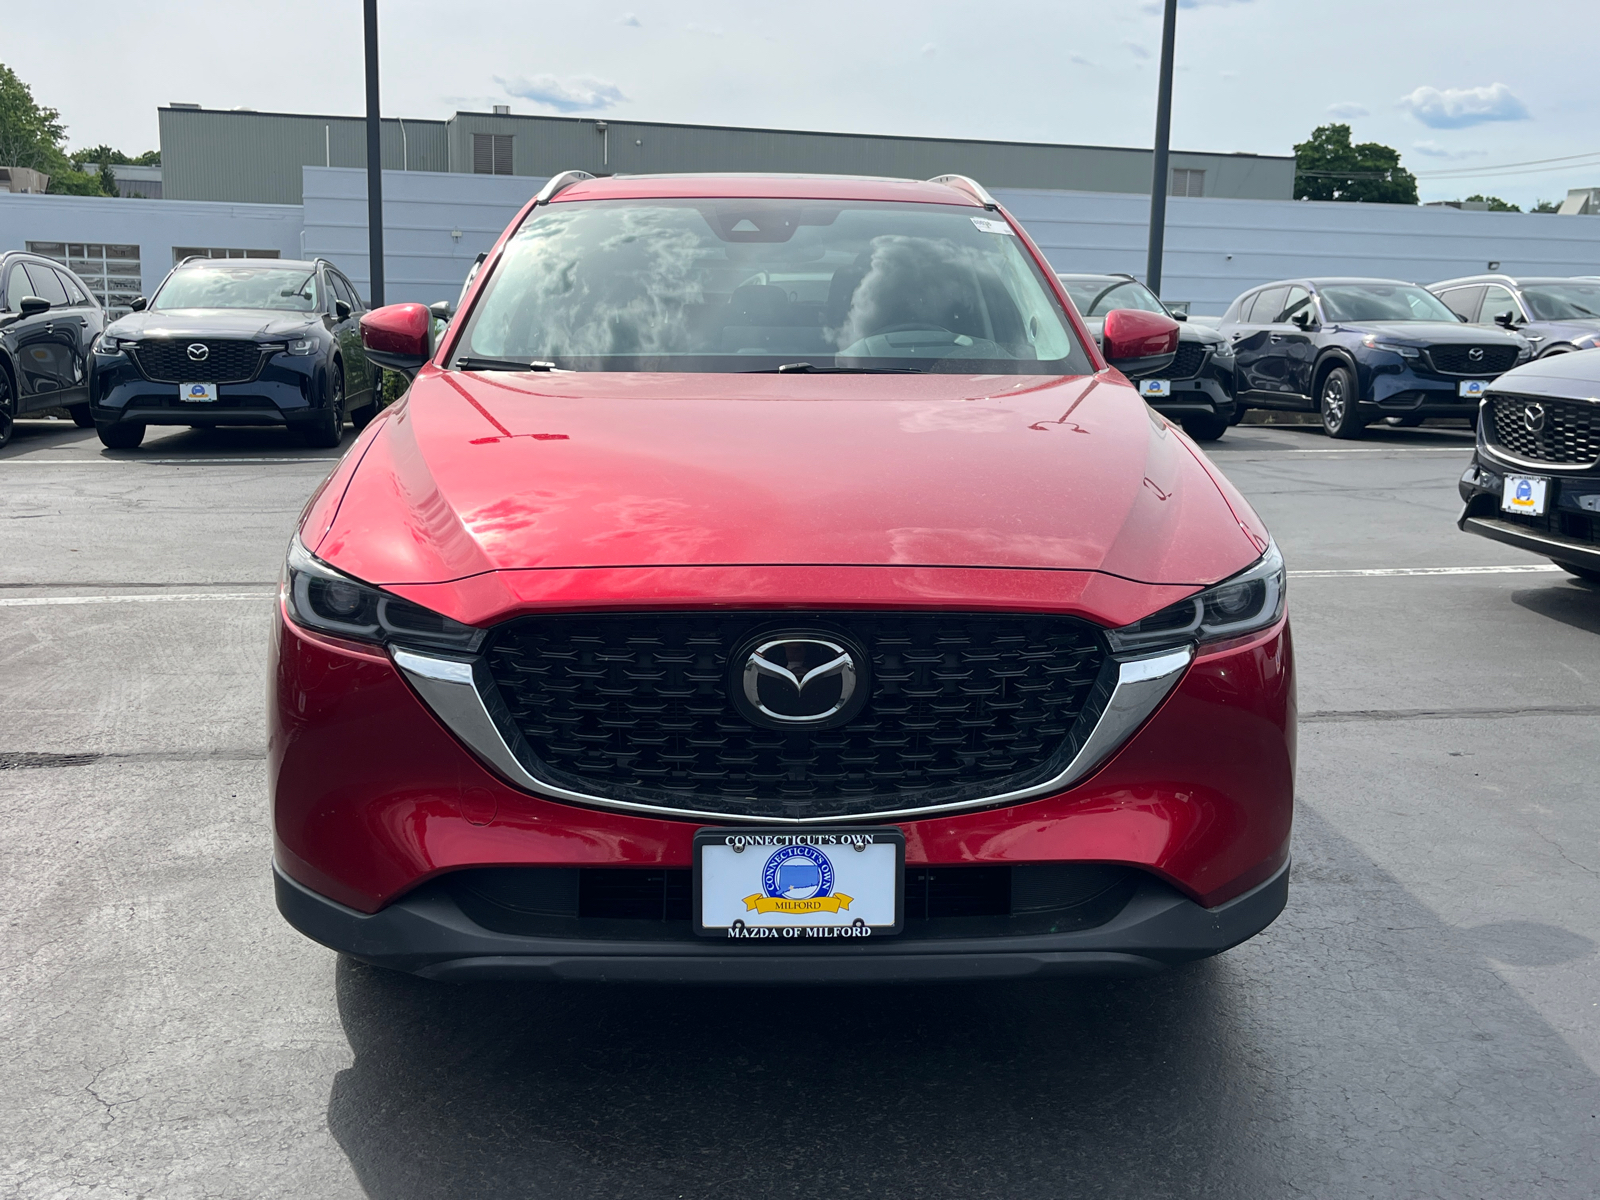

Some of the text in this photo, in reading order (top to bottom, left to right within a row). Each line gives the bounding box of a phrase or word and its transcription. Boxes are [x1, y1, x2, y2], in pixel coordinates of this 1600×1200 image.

[725, 834, 874, 846] CONNECTICUT'S OWN
[765, 847, 831, 891] CONNECTICUT'S OWN
[775, 901, 821, 910] MILFORD
[727, 926, 872, 938] MAZDA OF MILFORD
